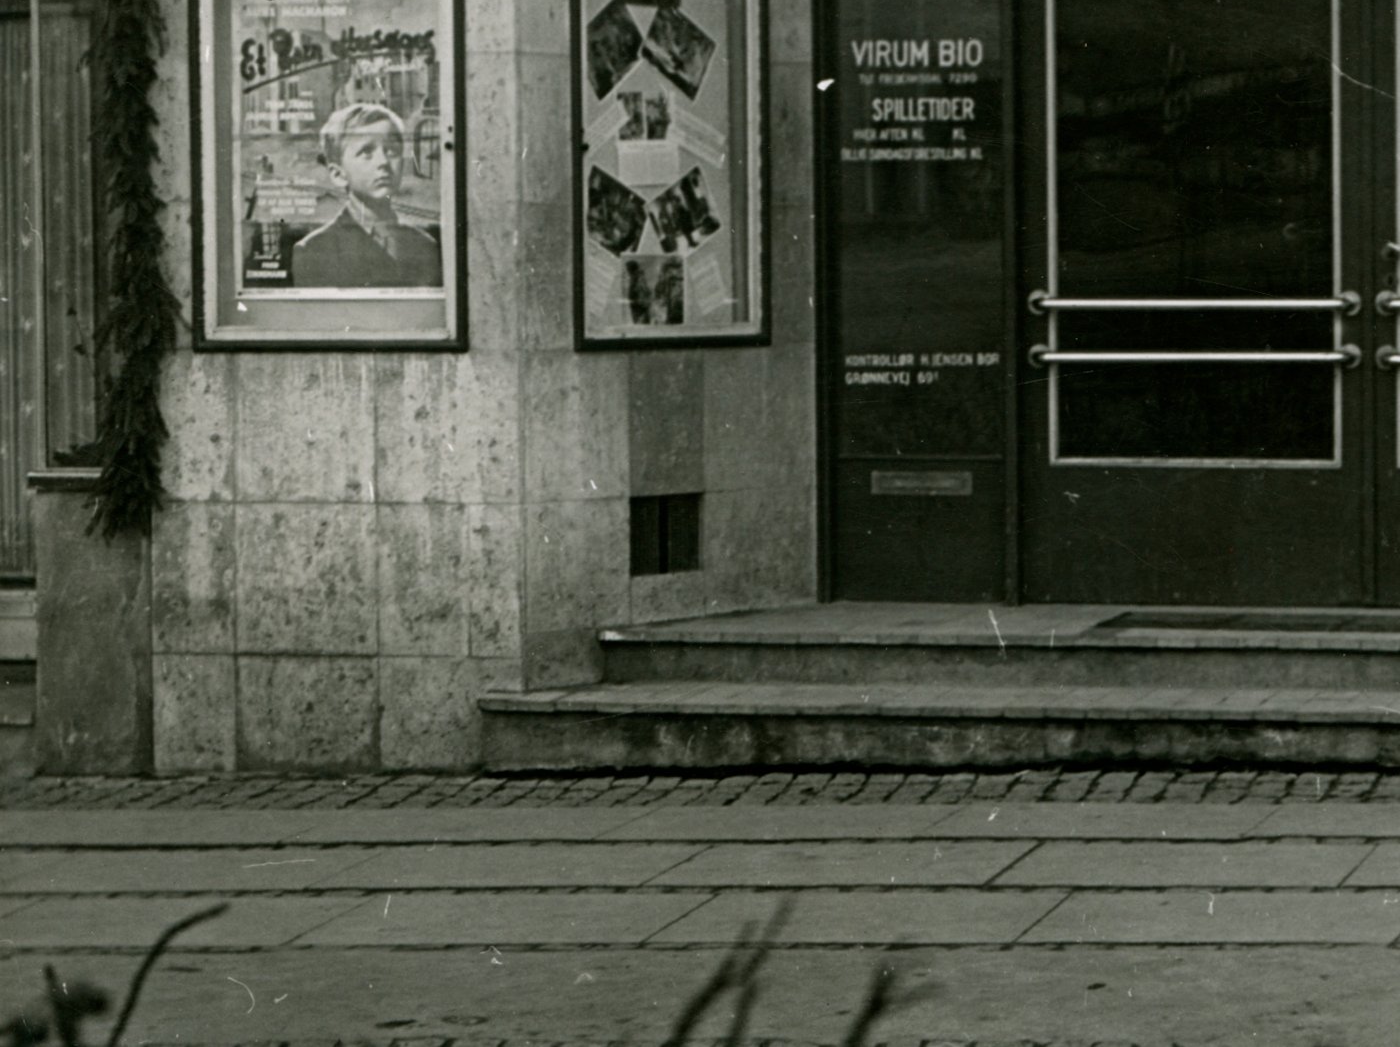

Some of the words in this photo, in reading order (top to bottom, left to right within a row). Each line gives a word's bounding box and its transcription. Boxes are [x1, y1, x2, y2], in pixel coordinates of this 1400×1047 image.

[240, 38, 266, 81] Et
[851, 39, 929, 67] VIRUM
[938, 38, 984, 67] BIO
[871, 97, 976, 122] SPILLETIDER
[879, 128, 908, 141] AFTEN
[844, 354, 914, 367] KONTROLLØR
[976, 352, 1000, 366] BOR
[844, 371, 911, 386] GRØNNEVEJ
